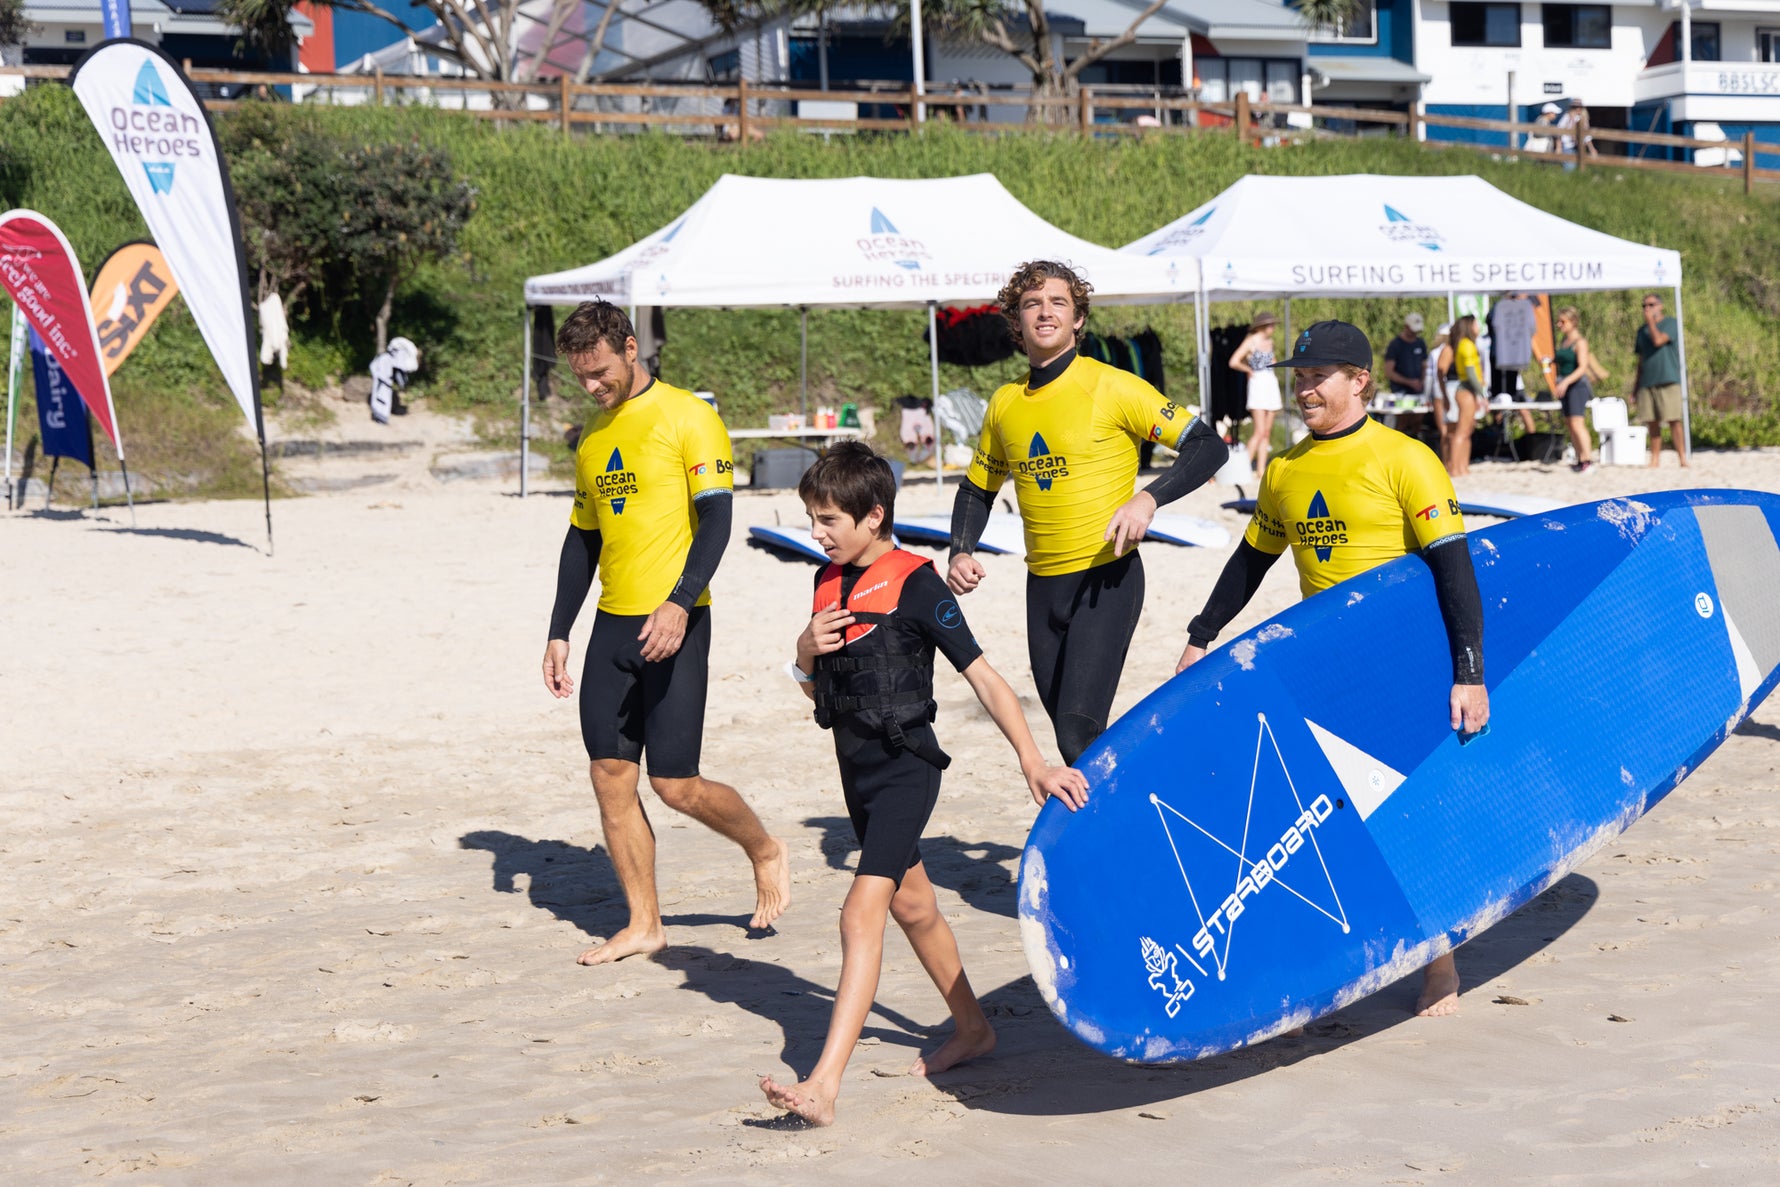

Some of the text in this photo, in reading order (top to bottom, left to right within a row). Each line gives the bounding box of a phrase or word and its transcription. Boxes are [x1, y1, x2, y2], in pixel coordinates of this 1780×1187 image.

[111, 107, 200, 134] Ocean
[114, 133, 201, 157] Heroes
[857, 236, 925, 251] Ocean
[832, 274, 904, 288] SURFING
[911, 273, 939, 286] THE
[1292, 262, 1603, 284] SURFING THE SPECTRUM
[17, 286, 55, 328] good
[99, 260, 168, 358] SIXT
[1018, 456, 1067, 473] Ocean
[595, 472, 637, 487] Ocean
[599, 484, 639, 497] Heroes
[1296, 519, 1347, 535] Ocean
[1300, 533, 1349, 546] Heroes
[853, 580, 889, 601] marlin
